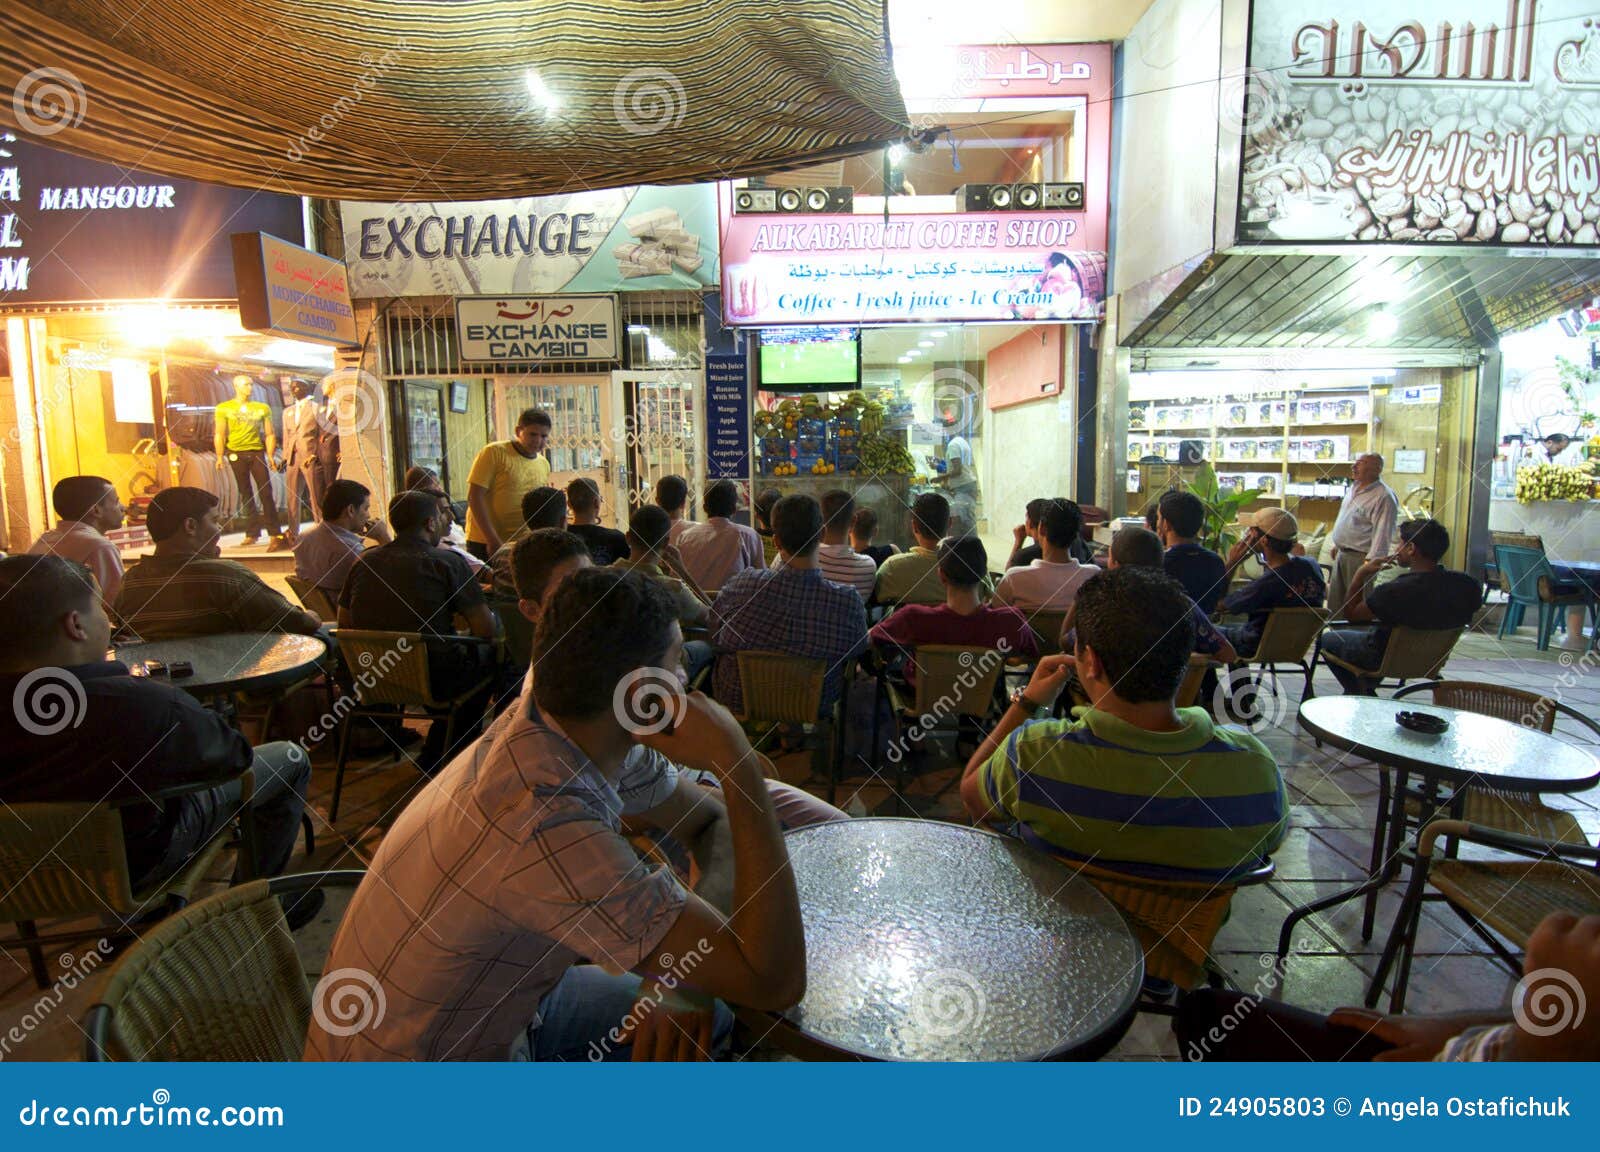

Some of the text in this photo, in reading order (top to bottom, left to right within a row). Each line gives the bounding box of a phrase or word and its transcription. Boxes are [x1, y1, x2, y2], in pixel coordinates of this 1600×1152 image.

[976, 50, 1091, 86] مرطبا
[40, 185, 175, 211] MANSOUR
[359, 211, 597, 262] EXCHANGE
[751, 219, 1077, 252] ALKABARITI COFFE SHOP
[496, 300, 574, 324] صرافة
[778, 292, 836, 315] Coffee
[855, 290, 903, 308] Fresh
[908, 290, 953, 312] juice
[993, 288, 1053, 305] Cream
[298, 312, 336, 332] CAMBIO
[466, 323, 607, 341] EXCHANGE
[489, 341, 588, 358] CAMBIO
[719, 417, 736, 425] Apple
